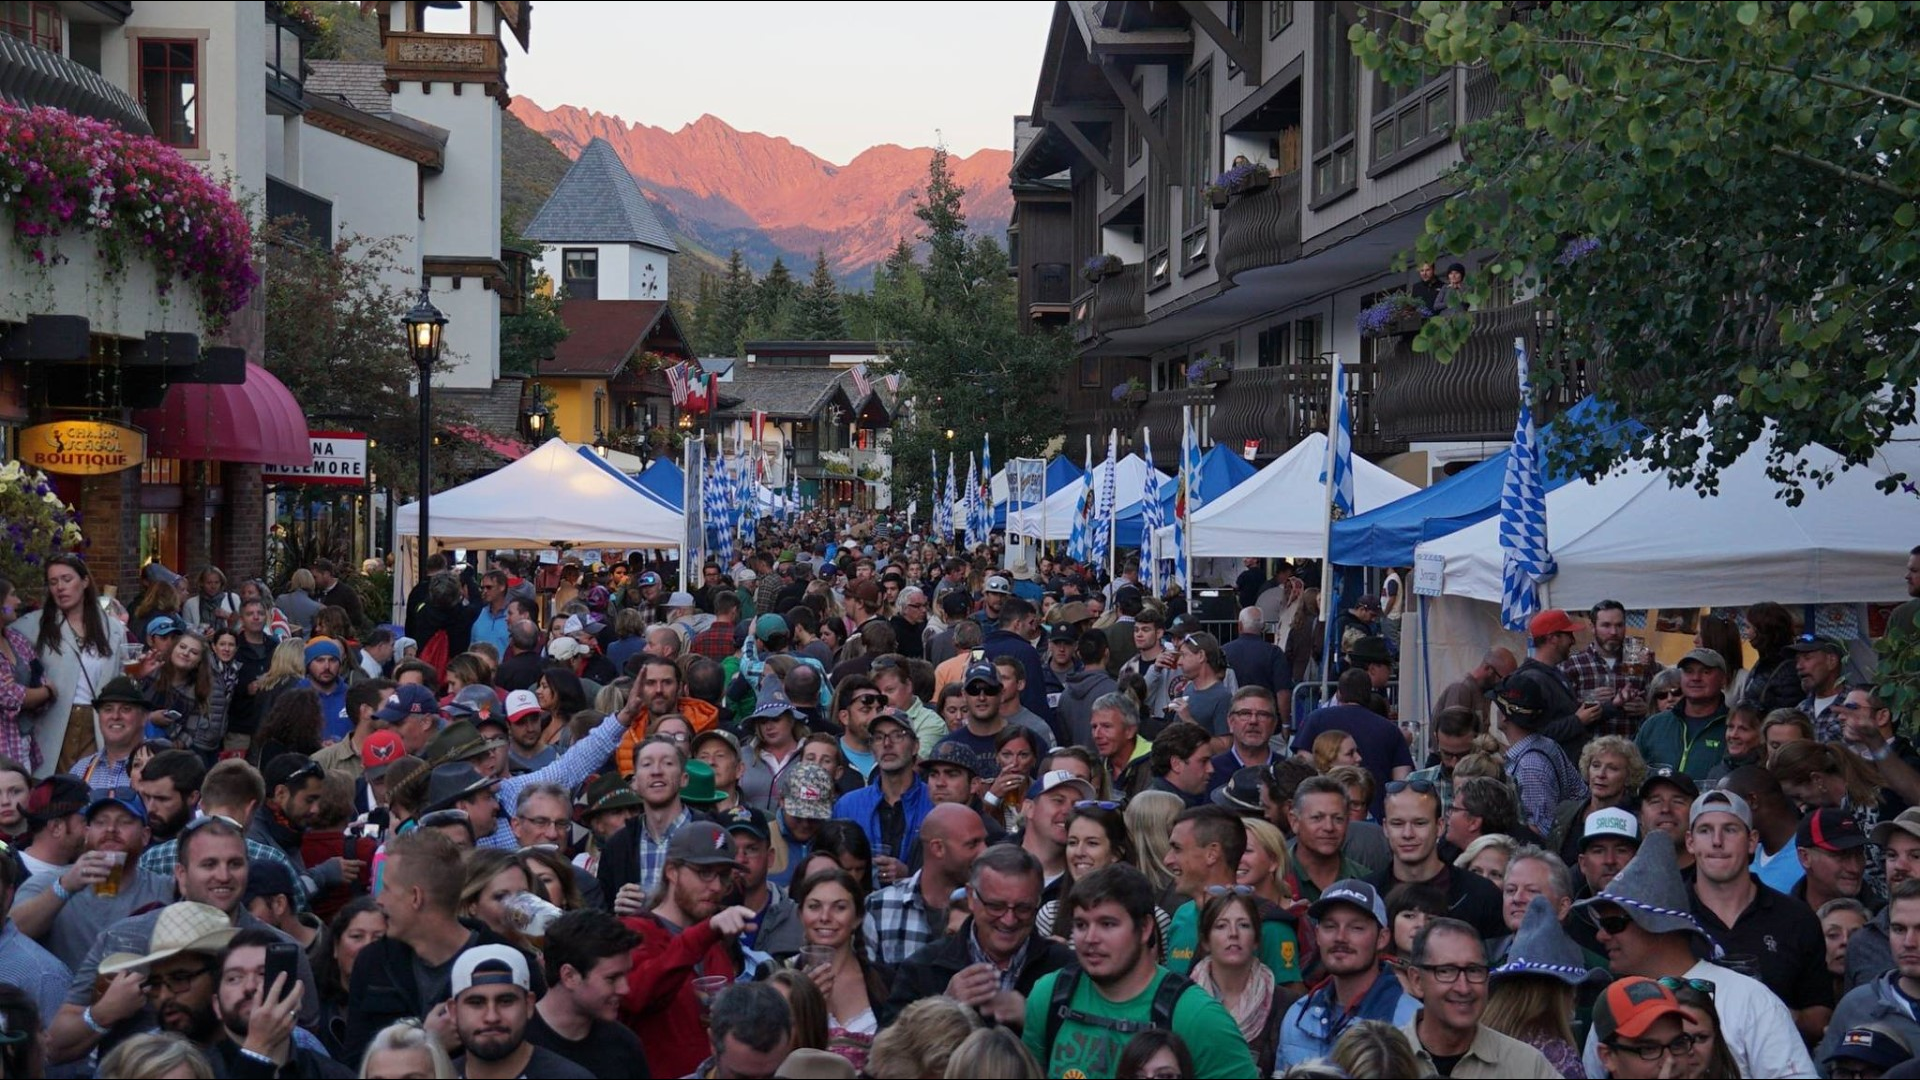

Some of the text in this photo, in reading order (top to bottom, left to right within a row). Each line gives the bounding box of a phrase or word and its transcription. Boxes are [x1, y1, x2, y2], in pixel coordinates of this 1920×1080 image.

[313, 442, 334, 455] NA
[34, 452, 128, 466] BOUTIQUE
[1596, 816, 1628, 831] SAUSAGE
[1326, 889, 1368, 902] HEAD
